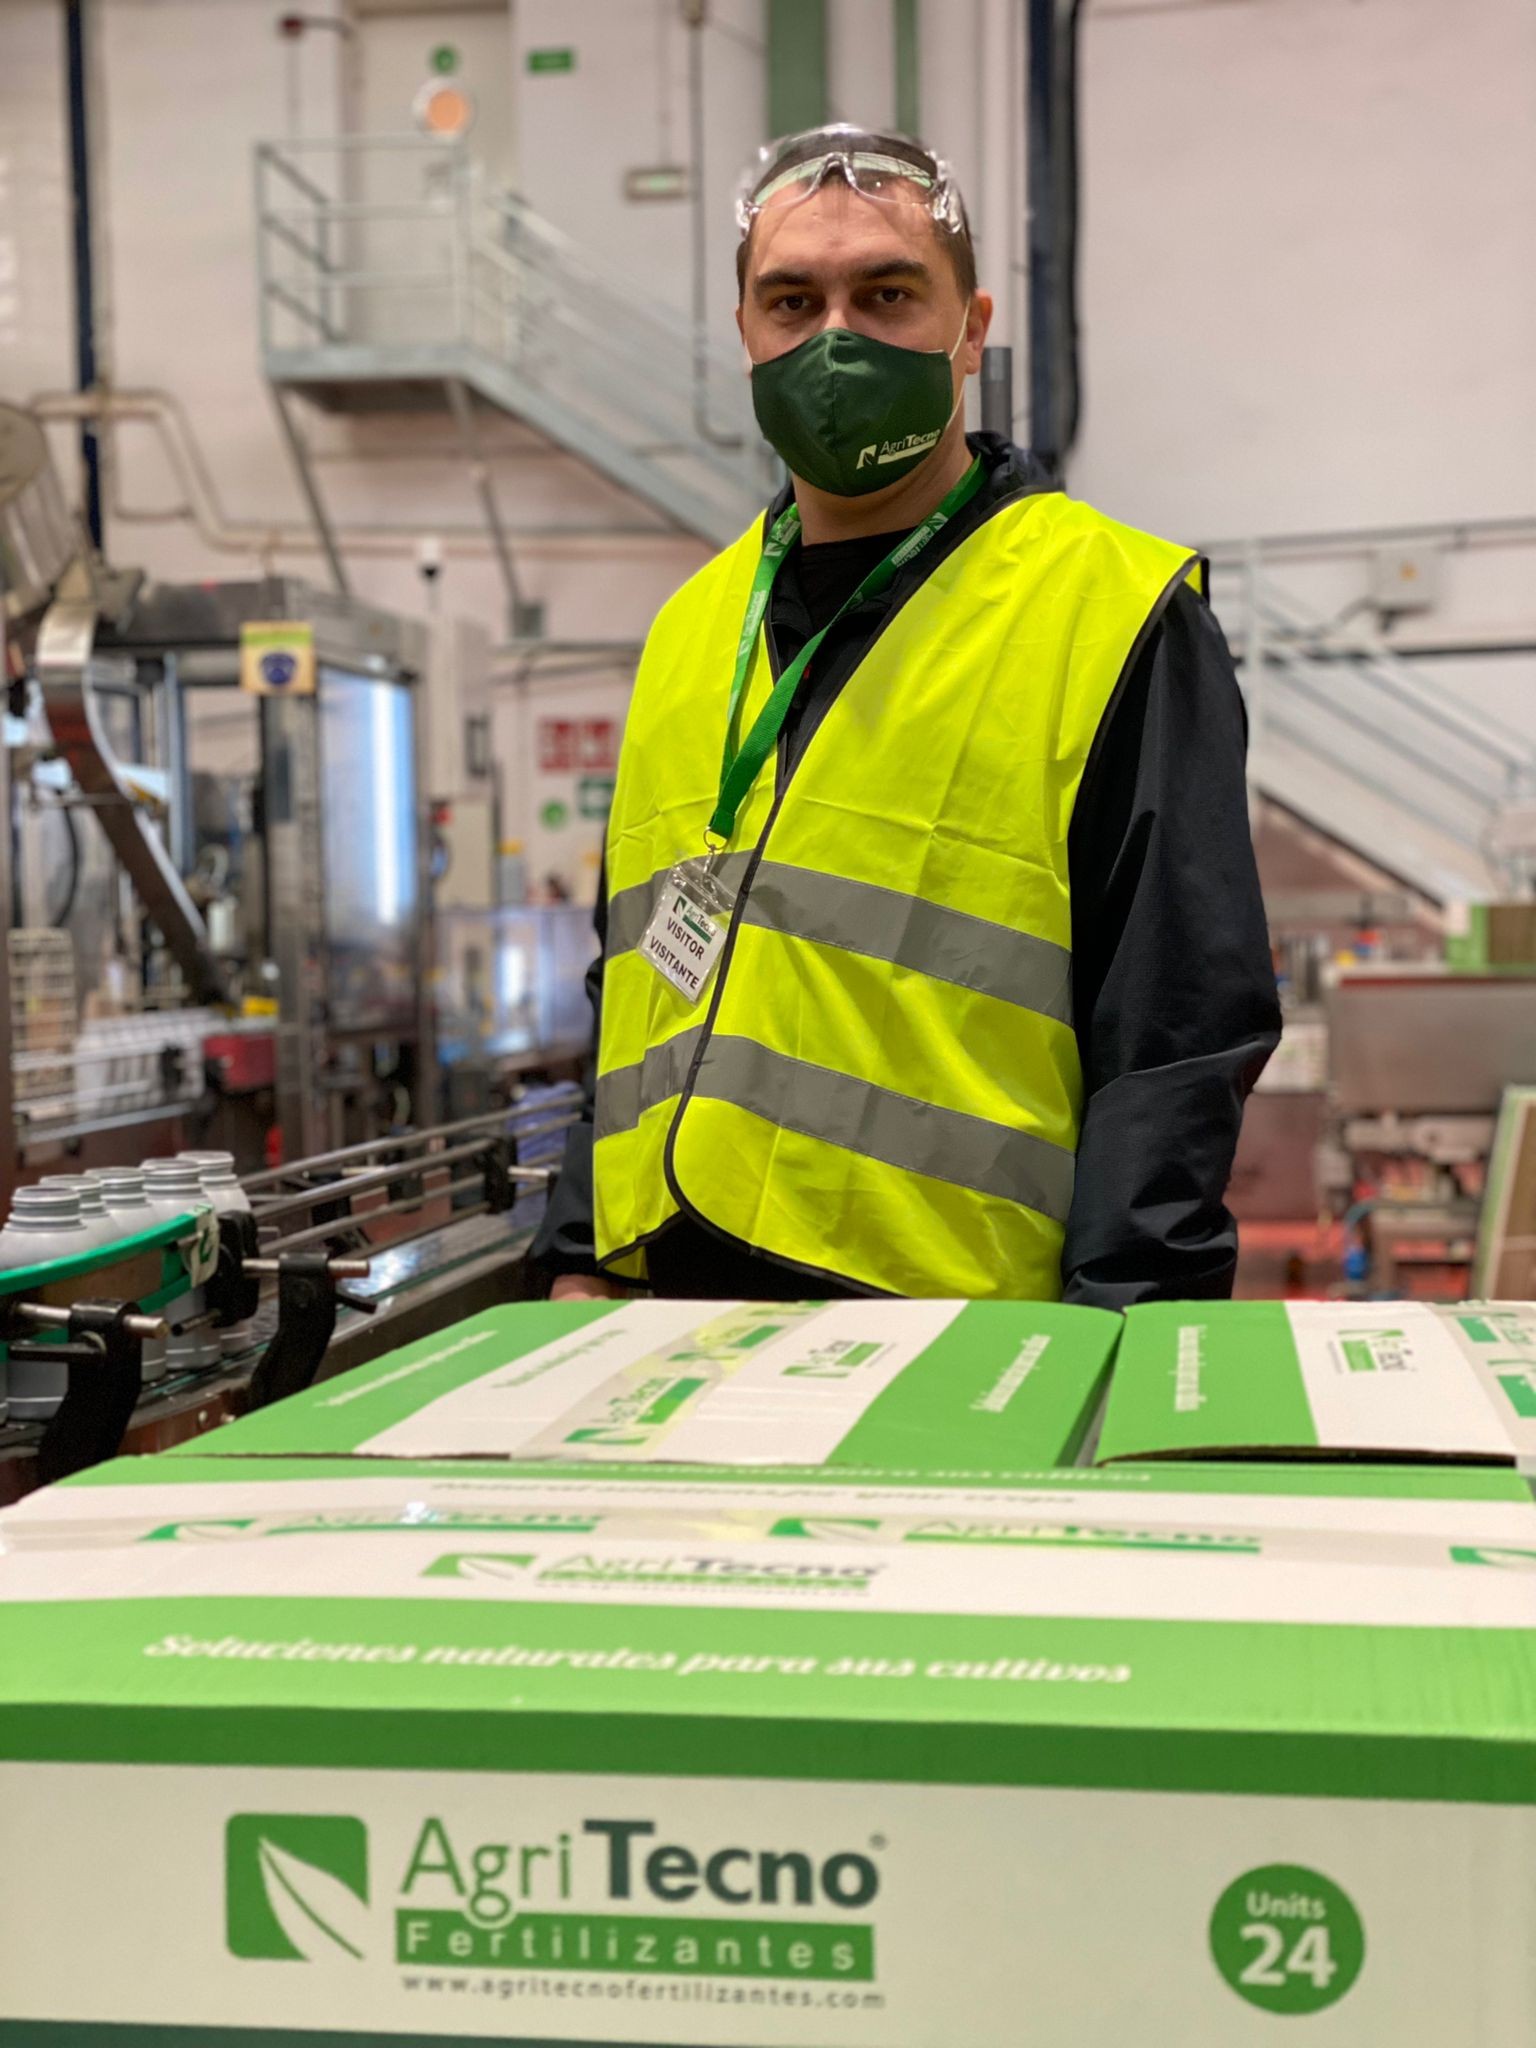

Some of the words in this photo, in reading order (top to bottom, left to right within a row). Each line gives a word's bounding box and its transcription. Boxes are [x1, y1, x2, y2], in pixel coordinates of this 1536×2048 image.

[880, 428, 941, 457] AgriTecno
[666, 916, 705, 961] VISITOR
[650, 936, 700, 989] VISITANTE
[143, 1634, 418, 1664] Soluciones
[421, 1643, 677, 1671] naturales
[677, 1651, 818, 1677] para
[825, 1656, 916, 1679] sus
[925, 1655, 1132, 1684] cultivos
[1245, 1890, 1327, 1920] Units
[405, 1919, 856, 1971] Fertilizantes
[1240, 1921, 1338, 1989] 24
[402, 1975, 887, 2009] www.agritecnofertilizantes.com
